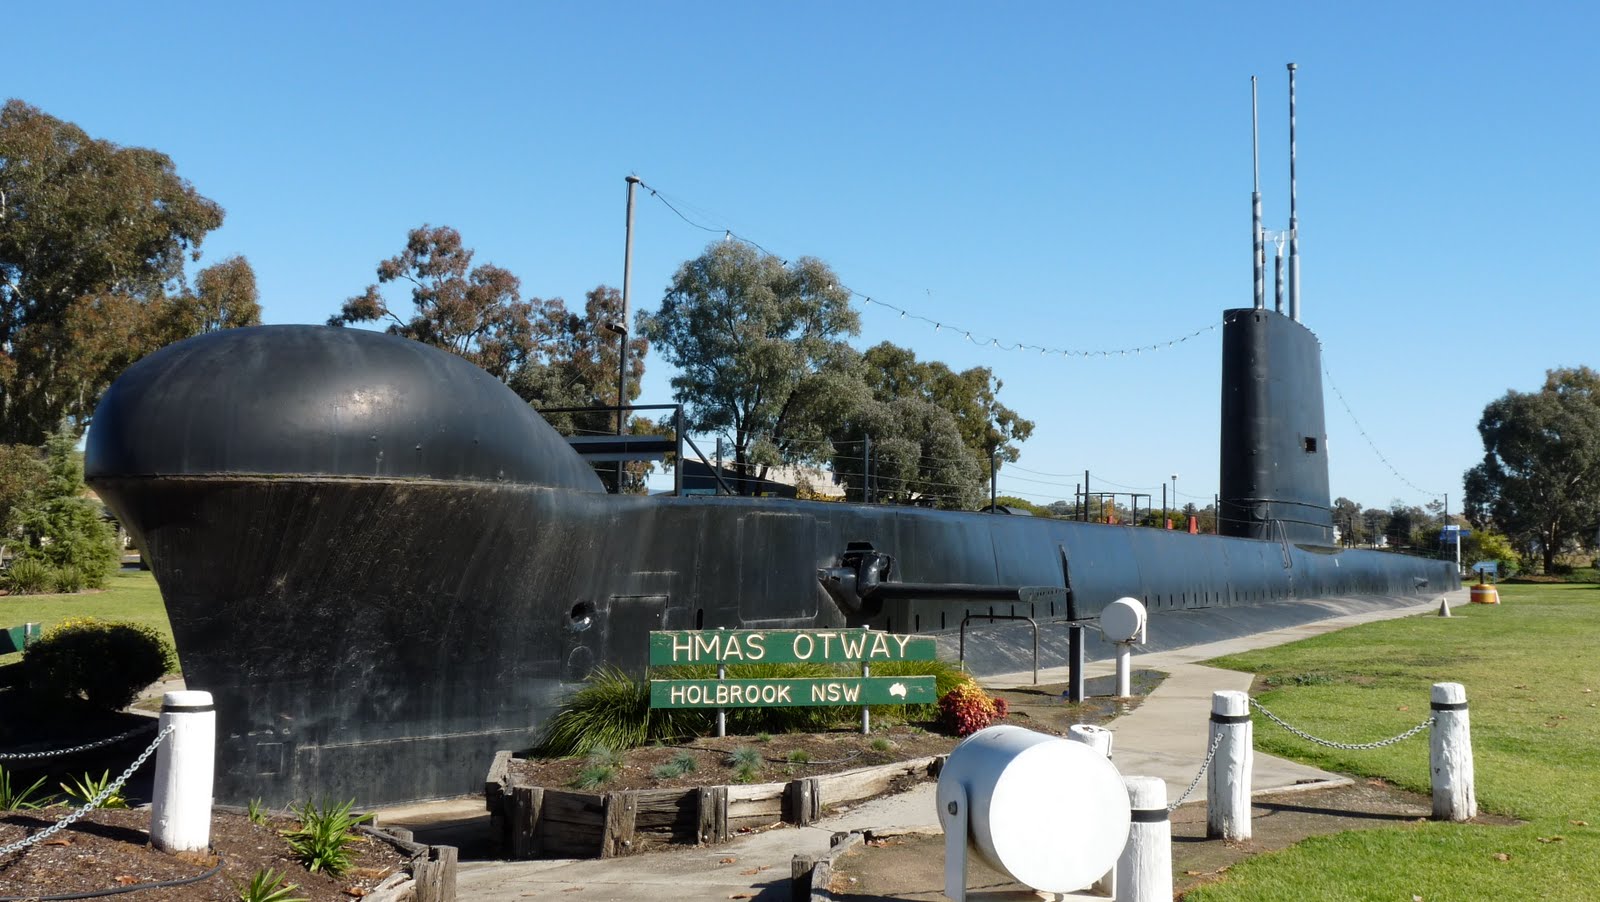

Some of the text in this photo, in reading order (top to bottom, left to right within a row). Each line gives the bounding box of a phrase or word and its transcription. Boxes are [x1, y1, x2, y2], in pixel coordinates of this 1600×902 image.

[671, 633, 912, 662] HMAS OTWAY
[670, 682, 861, 705] HOLBROOK NSW
